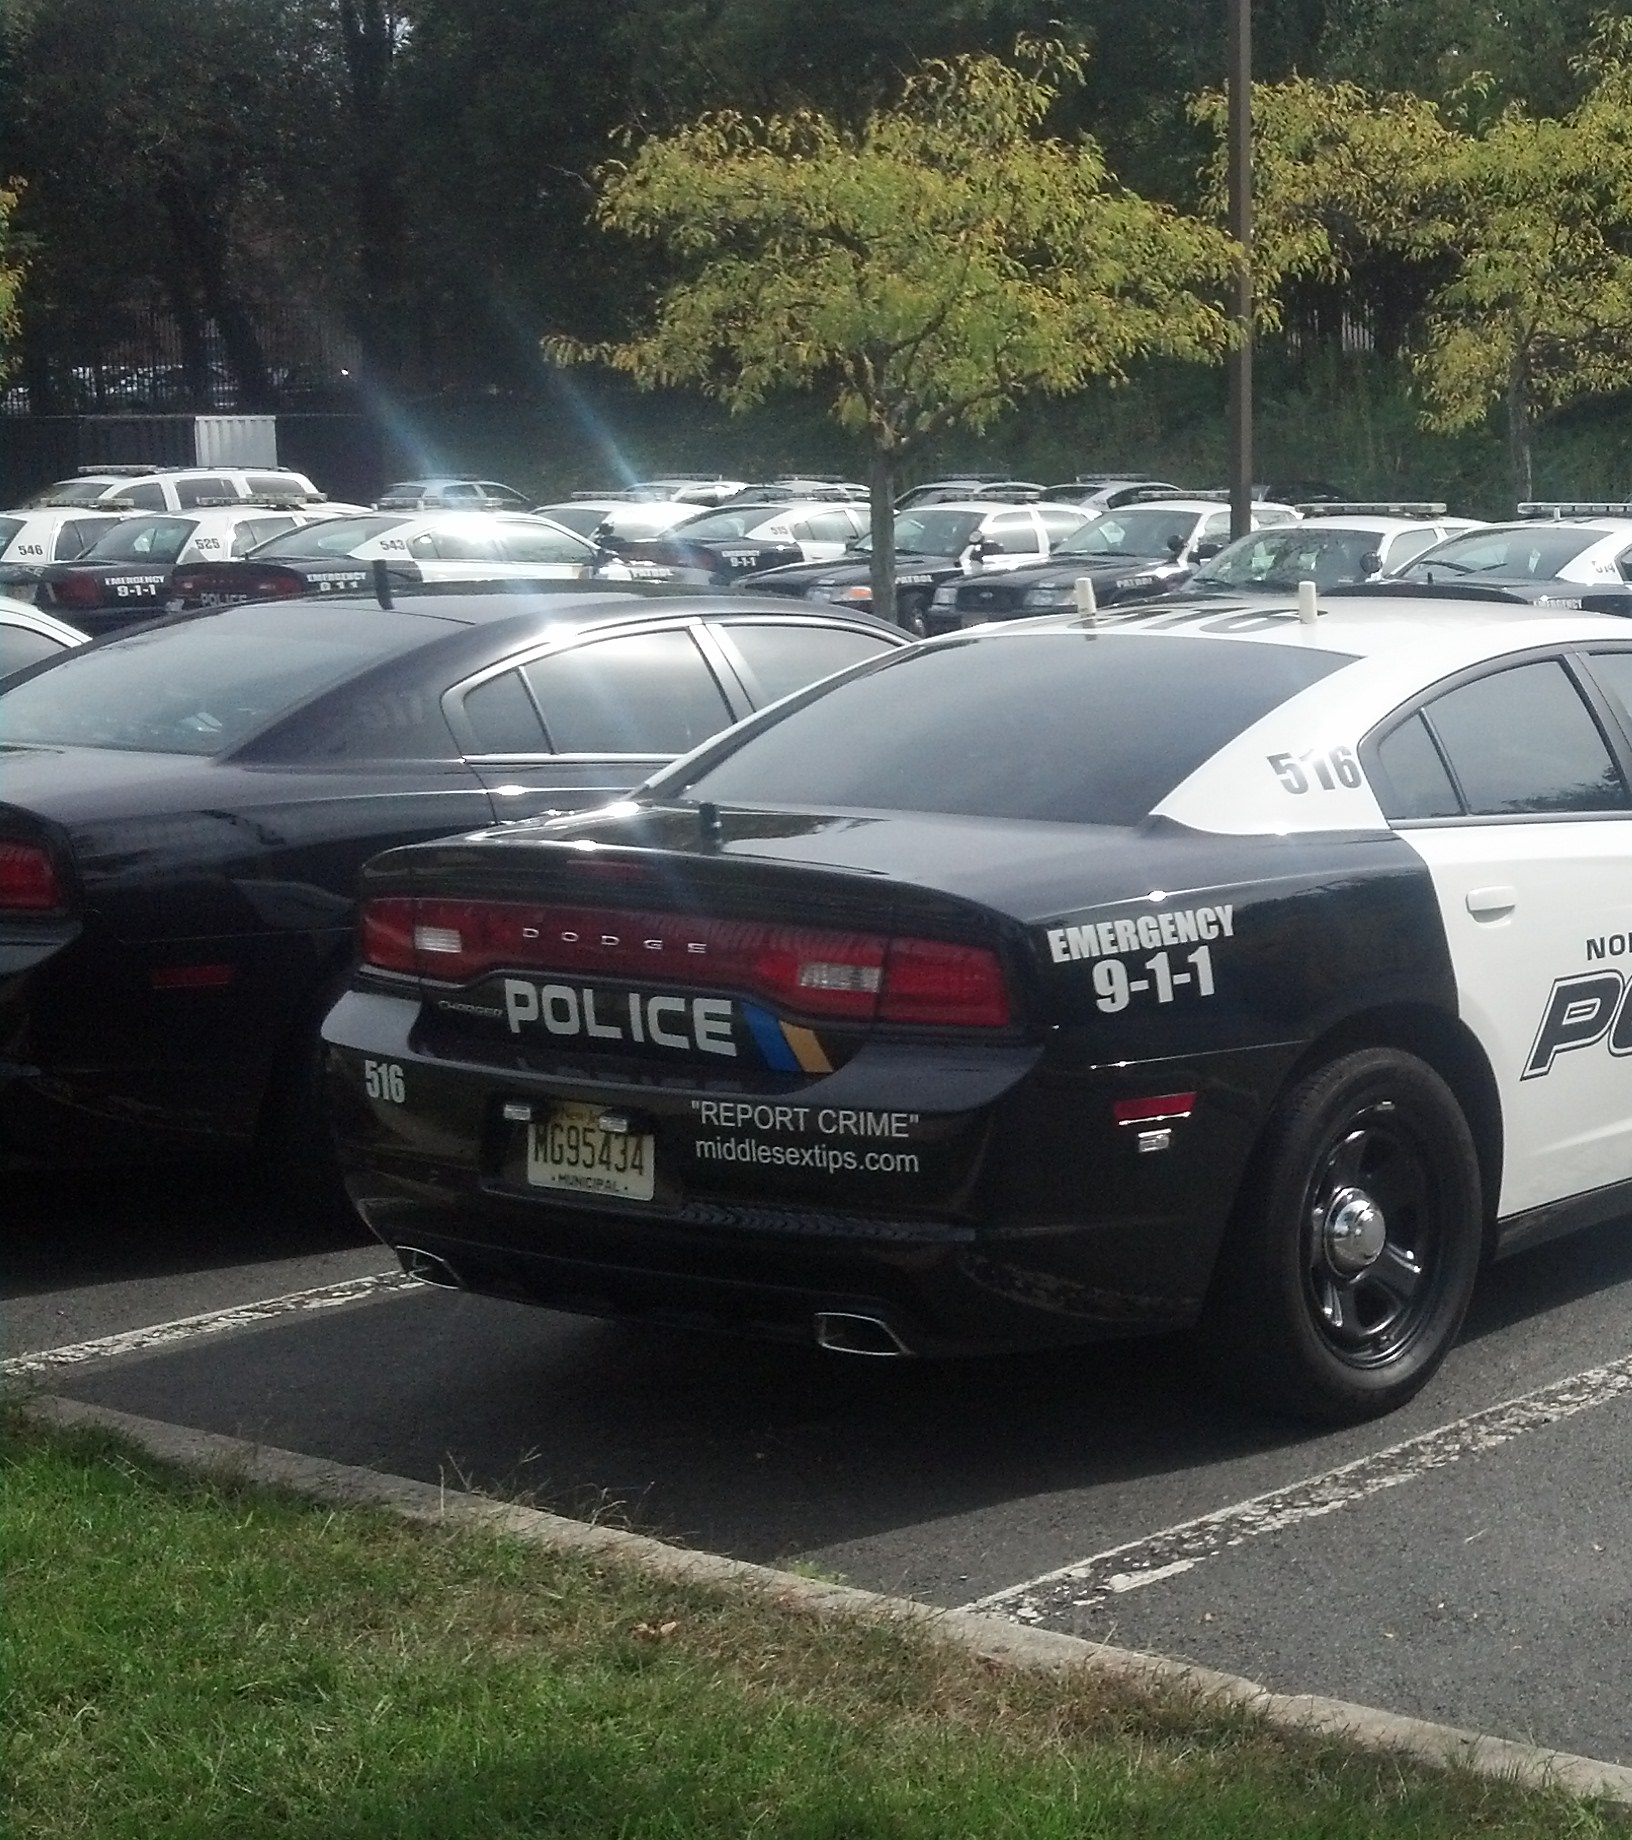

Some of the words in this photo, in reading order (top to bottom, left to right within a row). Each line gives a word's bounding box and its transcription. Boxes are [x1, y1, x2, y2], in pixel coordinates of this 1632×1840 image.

[18, 545, 43, 556] 546
[194, 538, 221, 550] 525
[117, 584, 157, 597] 9-1-1
[1266, 745, 1363, 795] 516
[522, 927, 707, 954] DODGE
[1047, 904, 1234, 963] EMERGENCY
[1092, 945, 1215, 1013] 9-1-1
[504, 979, 737, 1057] POLICE
[364, 1060, 406, 1104] 516
[691, 1100, 810, 1132] "REPORT
[817, 1109, 920, 1138] CRIME"
[533, 1123, 645, 1176] MG95434
[695, 1136, 920, 1174] middlesextips.com
